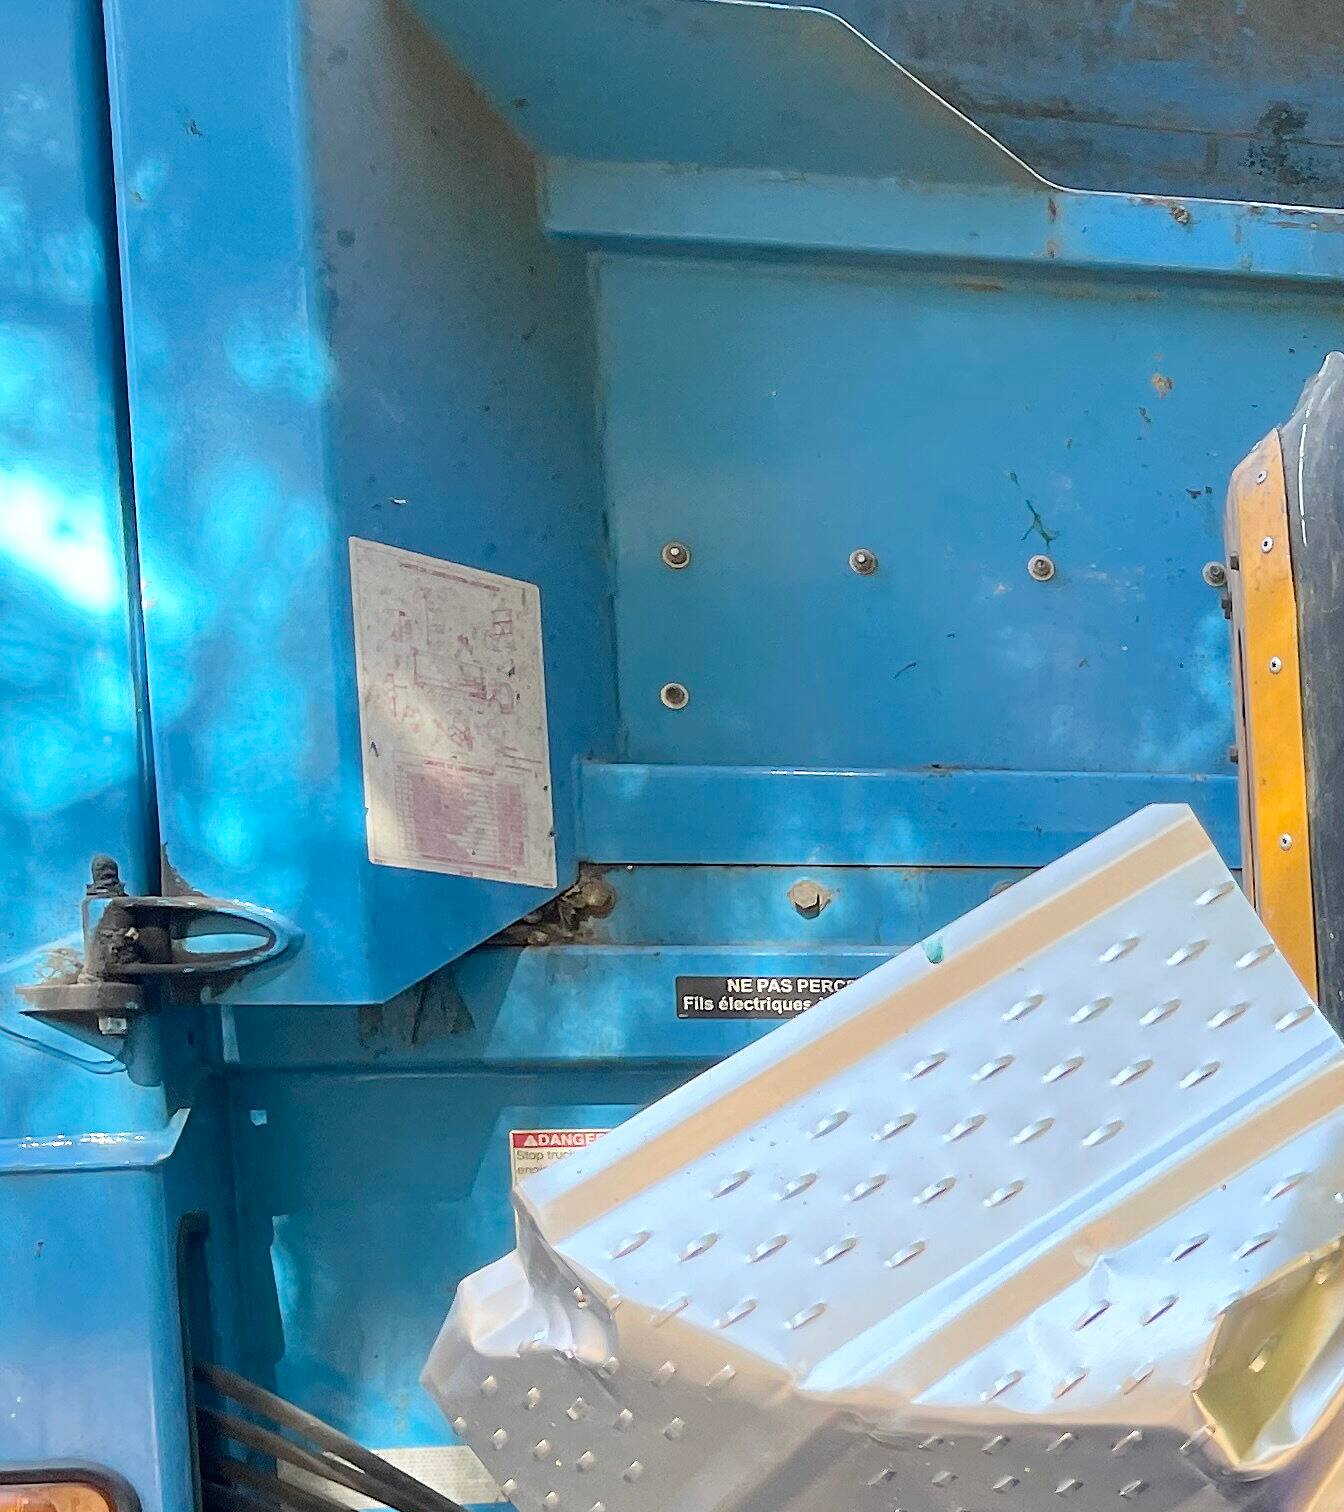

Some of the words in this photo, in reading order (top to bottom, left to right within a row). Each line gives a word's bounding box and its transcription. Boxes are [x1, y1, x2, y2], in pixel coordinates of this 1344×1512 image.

[726, 978, 753, 993] NE
[757, 978, 793, 993] PAS
[683, 995, 715, 1011] Fils
[718, 995, 812, 1015] électriques
[517, 1150, 544, 1163] Stop
